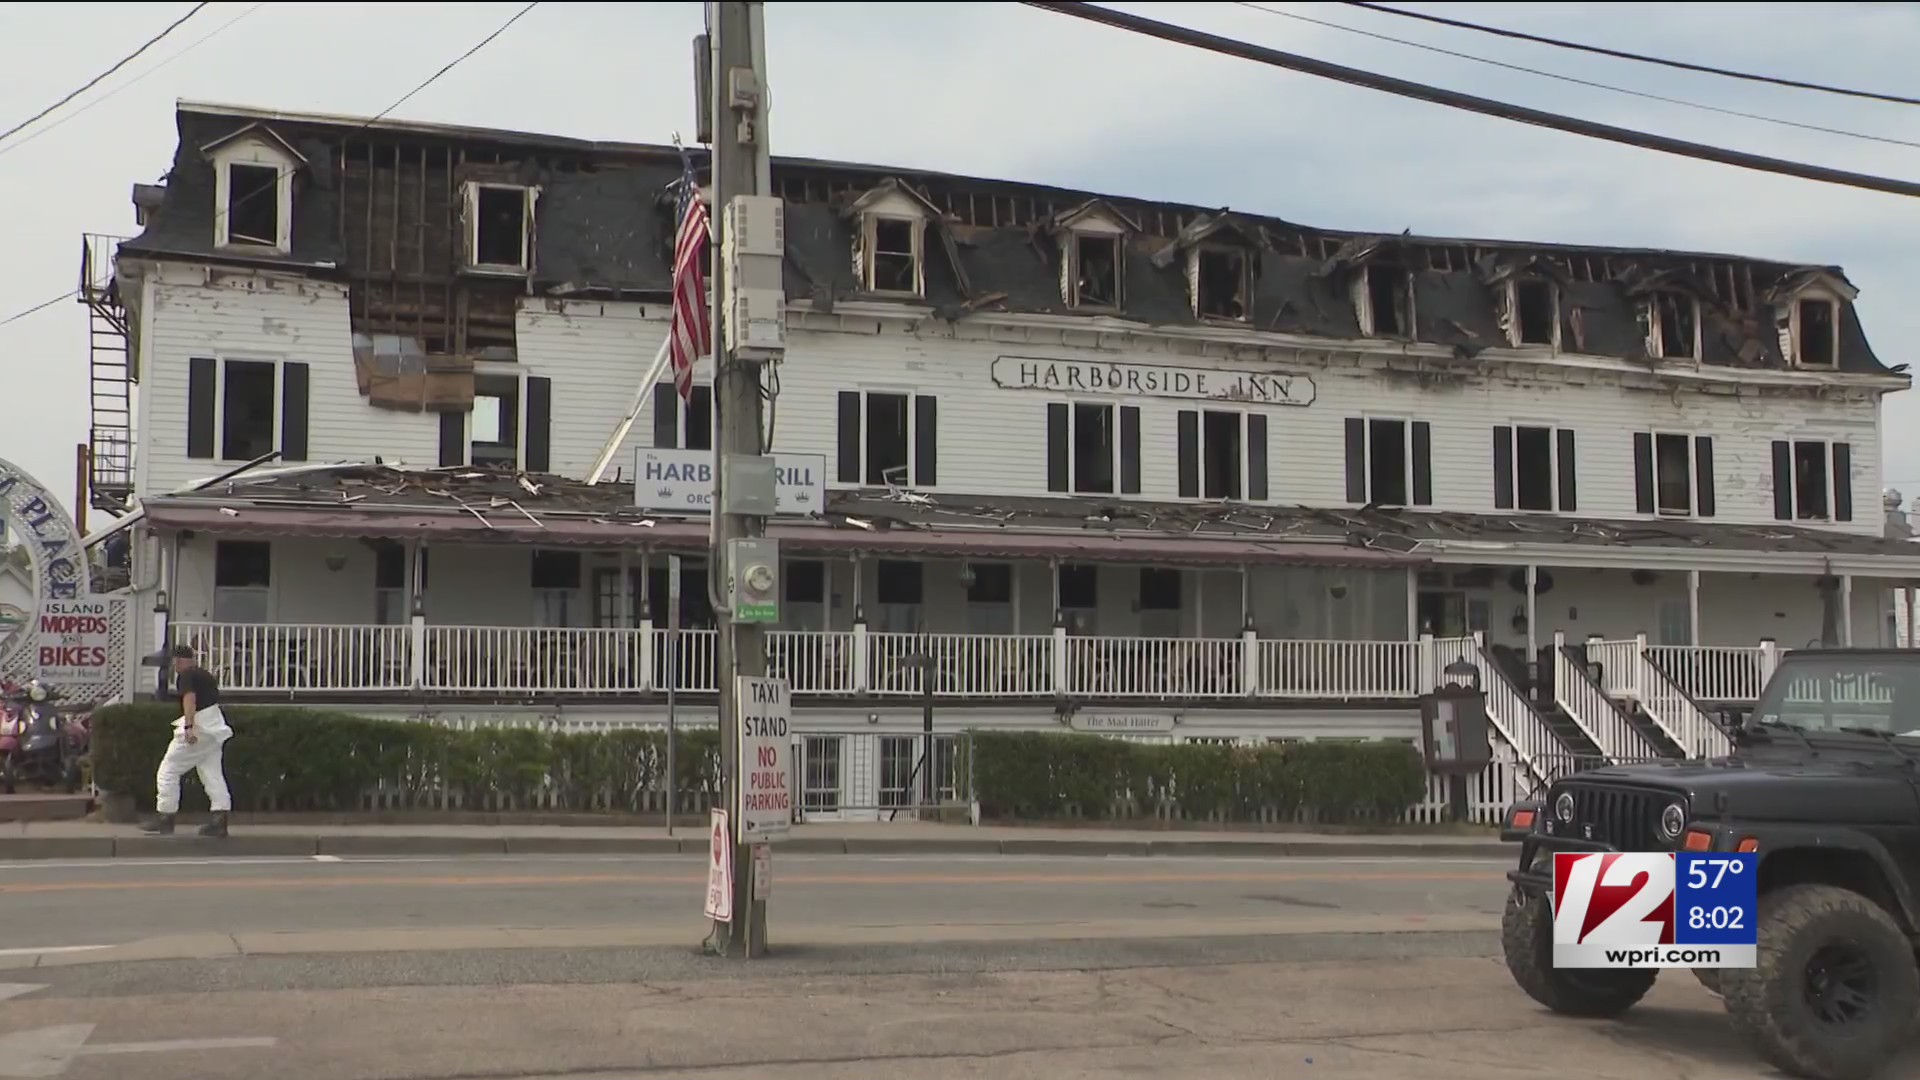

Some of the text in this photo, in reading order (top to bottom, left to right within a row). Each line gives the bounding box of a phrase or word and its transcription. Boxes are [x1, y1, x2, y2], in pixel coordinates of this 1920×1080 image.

[1020, 363, 1292, 398] HARBORSIDE INN
[646, 462, 815, 486] HARB RILL
[686, 493, 711, 505] ORC
[21, 495, 77, 600] PLACE
[46, 603, 104, 614] ISLAND
[41, 615, 107, 634] MOPEDS
[39, 646, 106, 667] BIKES
[751, 683, 779, 704] TAXI
[745, 716, 787, 737] STAND
[1087, 716, 1104, 727] The
[757, 746, 777, 767] NO
[751, 772, 786, 789] PUBLIC
[745, 793, 789, 811] PARKING
